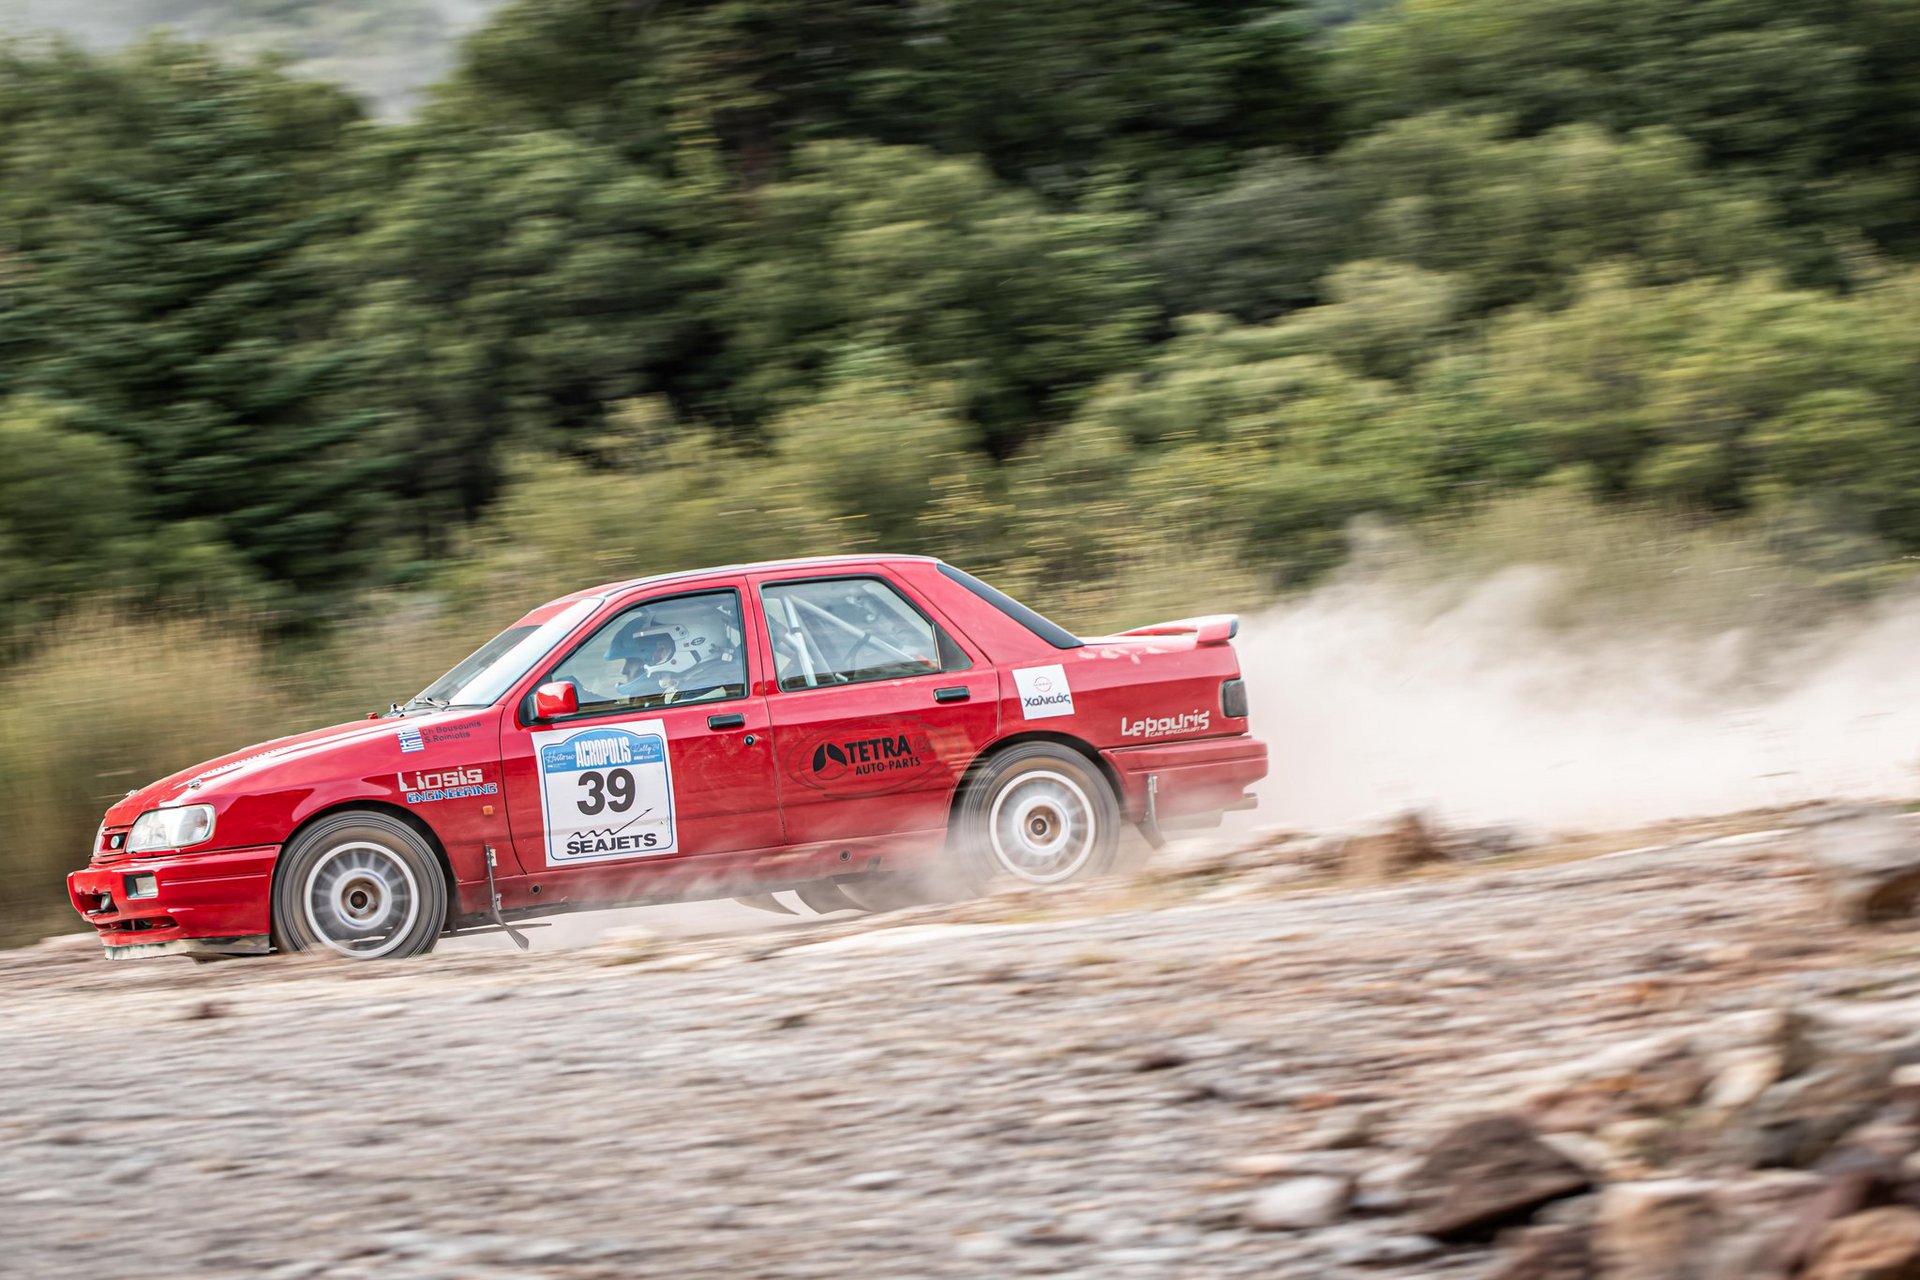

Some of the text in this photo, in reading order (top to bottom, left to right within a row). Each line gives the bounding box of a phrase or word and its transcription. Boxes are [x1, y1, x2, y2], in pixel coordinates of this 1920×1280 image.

[1121, 709, 1210, 738] Lepouris
[574, 736, 631, 767] ACROPOLIS
[844, 734, 912, 763] TETRA
[397, 766, 483, 792] Liosis
[855, 757, 921, 776] AUTO PARTS
[406, 782, 498, 804] ENGINEERING
[577, 768, 636, 816] 39
[566, 833, 657, 855] SEAJETS
